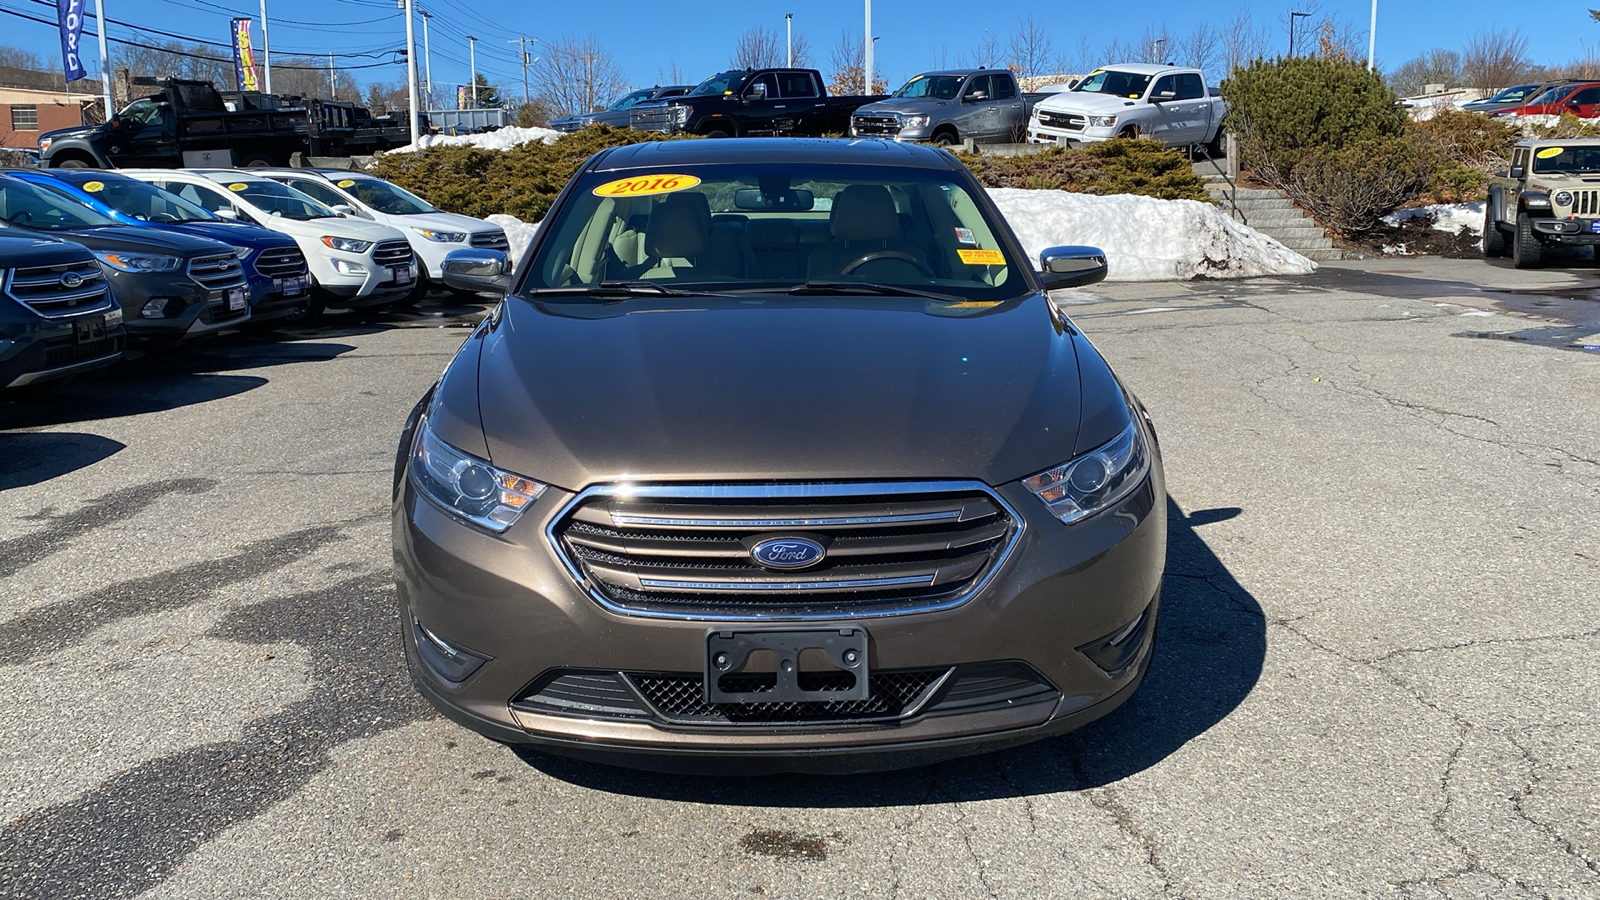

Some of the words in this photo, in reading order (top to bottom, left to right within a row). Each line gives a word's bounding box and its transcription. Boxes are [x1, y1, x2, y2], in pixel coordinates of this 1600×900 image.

[66, 0, 79, 71] FORD
[610, 176, 684, 195] 2016
[768, 544, 807, 560] Ford
